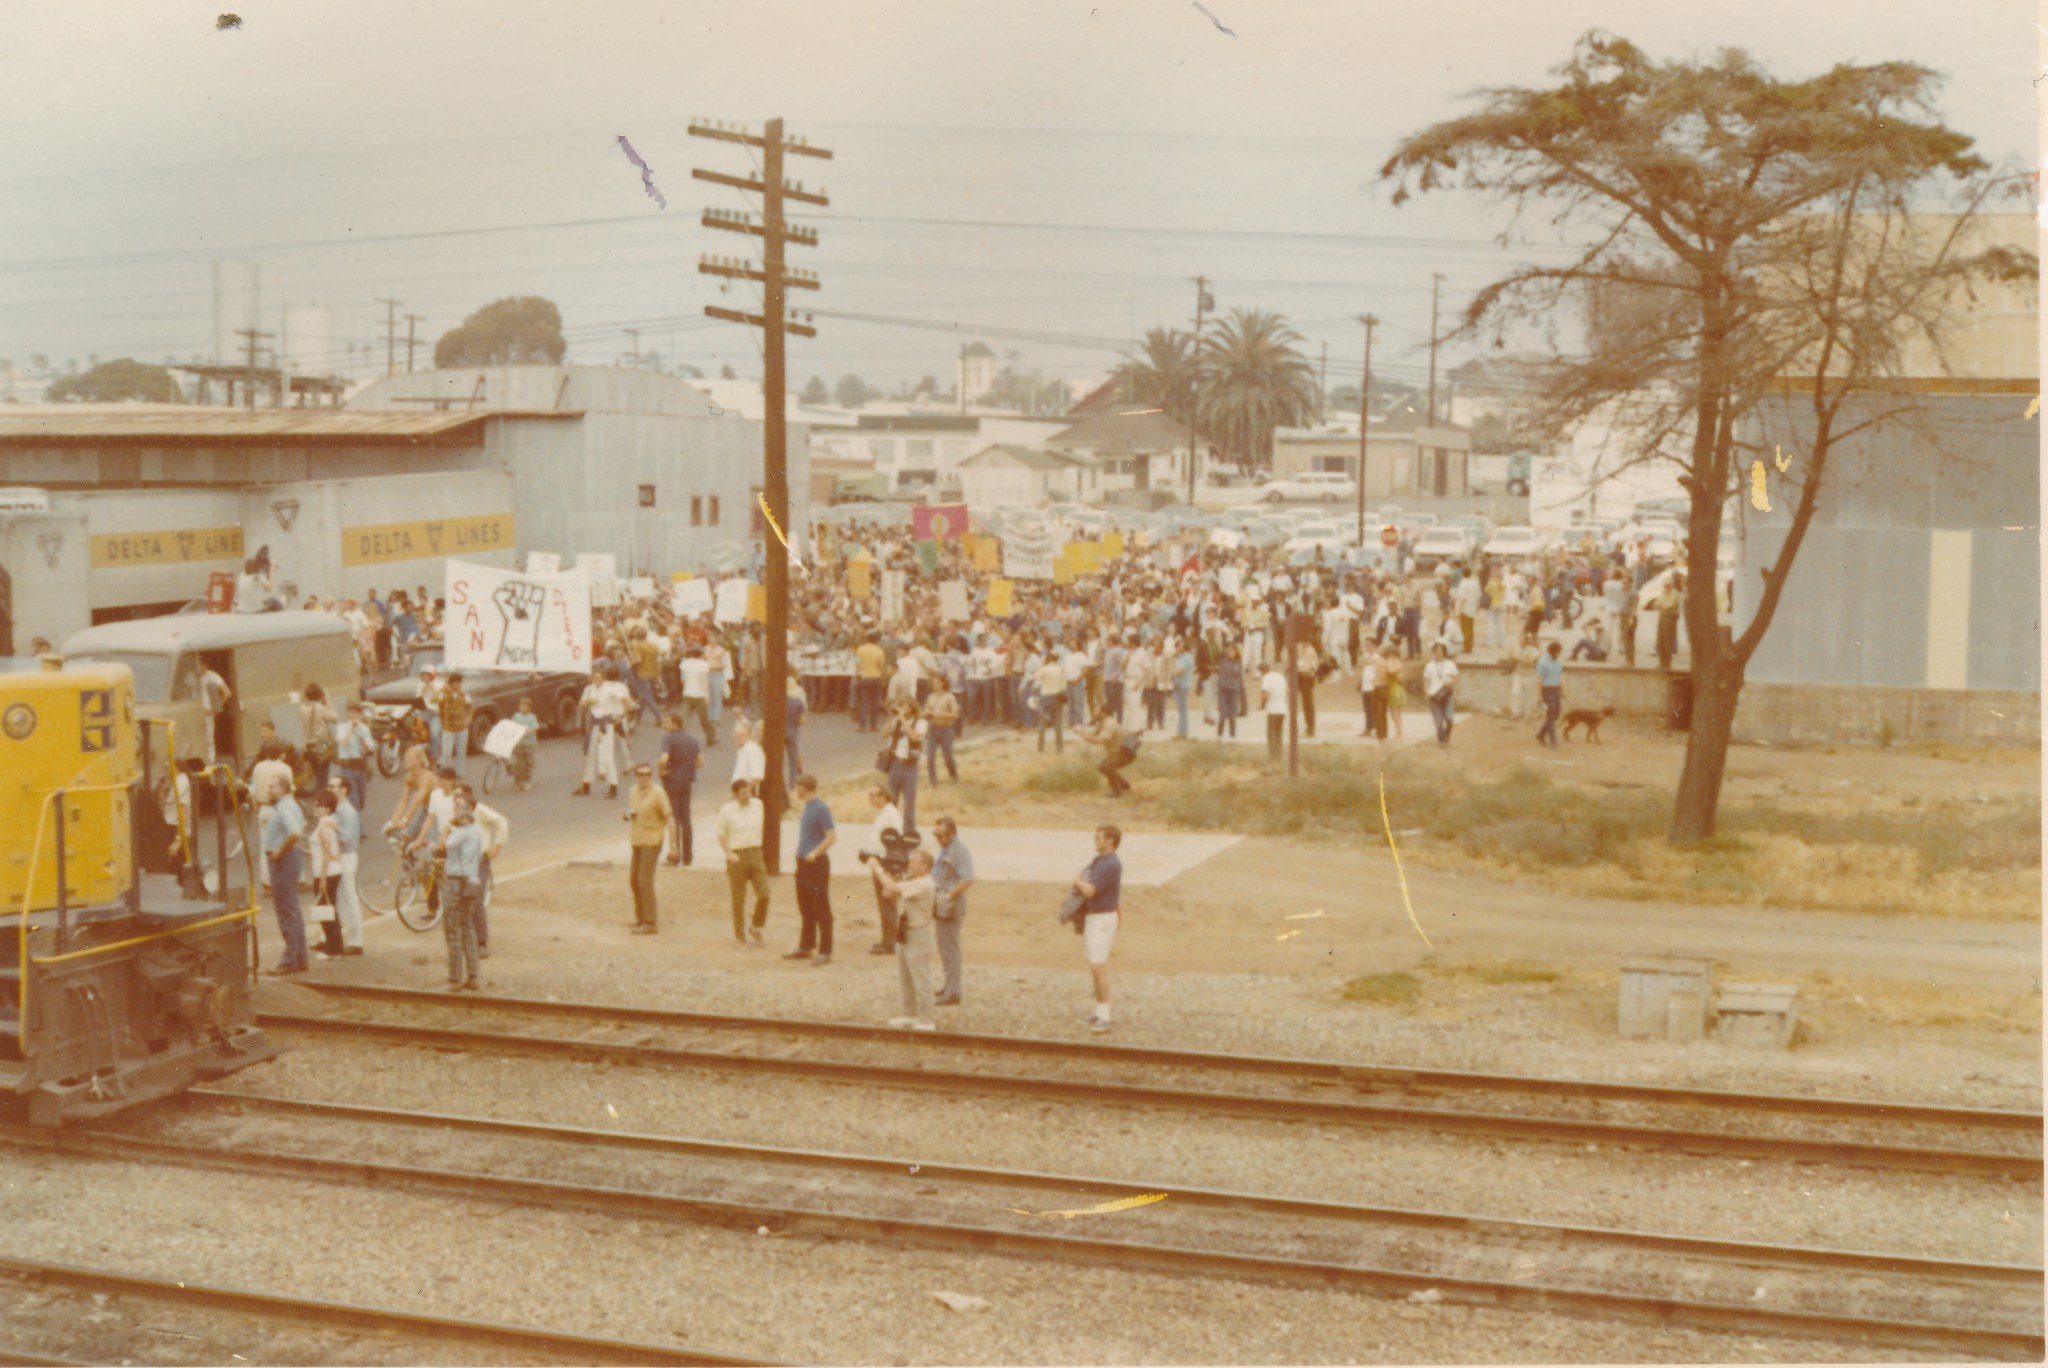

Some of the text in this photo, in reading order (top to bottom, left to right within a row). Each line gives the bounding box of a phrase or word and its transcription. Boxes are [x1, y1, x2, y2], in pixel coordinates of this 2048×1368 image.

[106, 533, 241, 560] DELTA LINE
[359, 521, 502, 557] DELTA LINES
[451, 580, 484, 652] SAN
